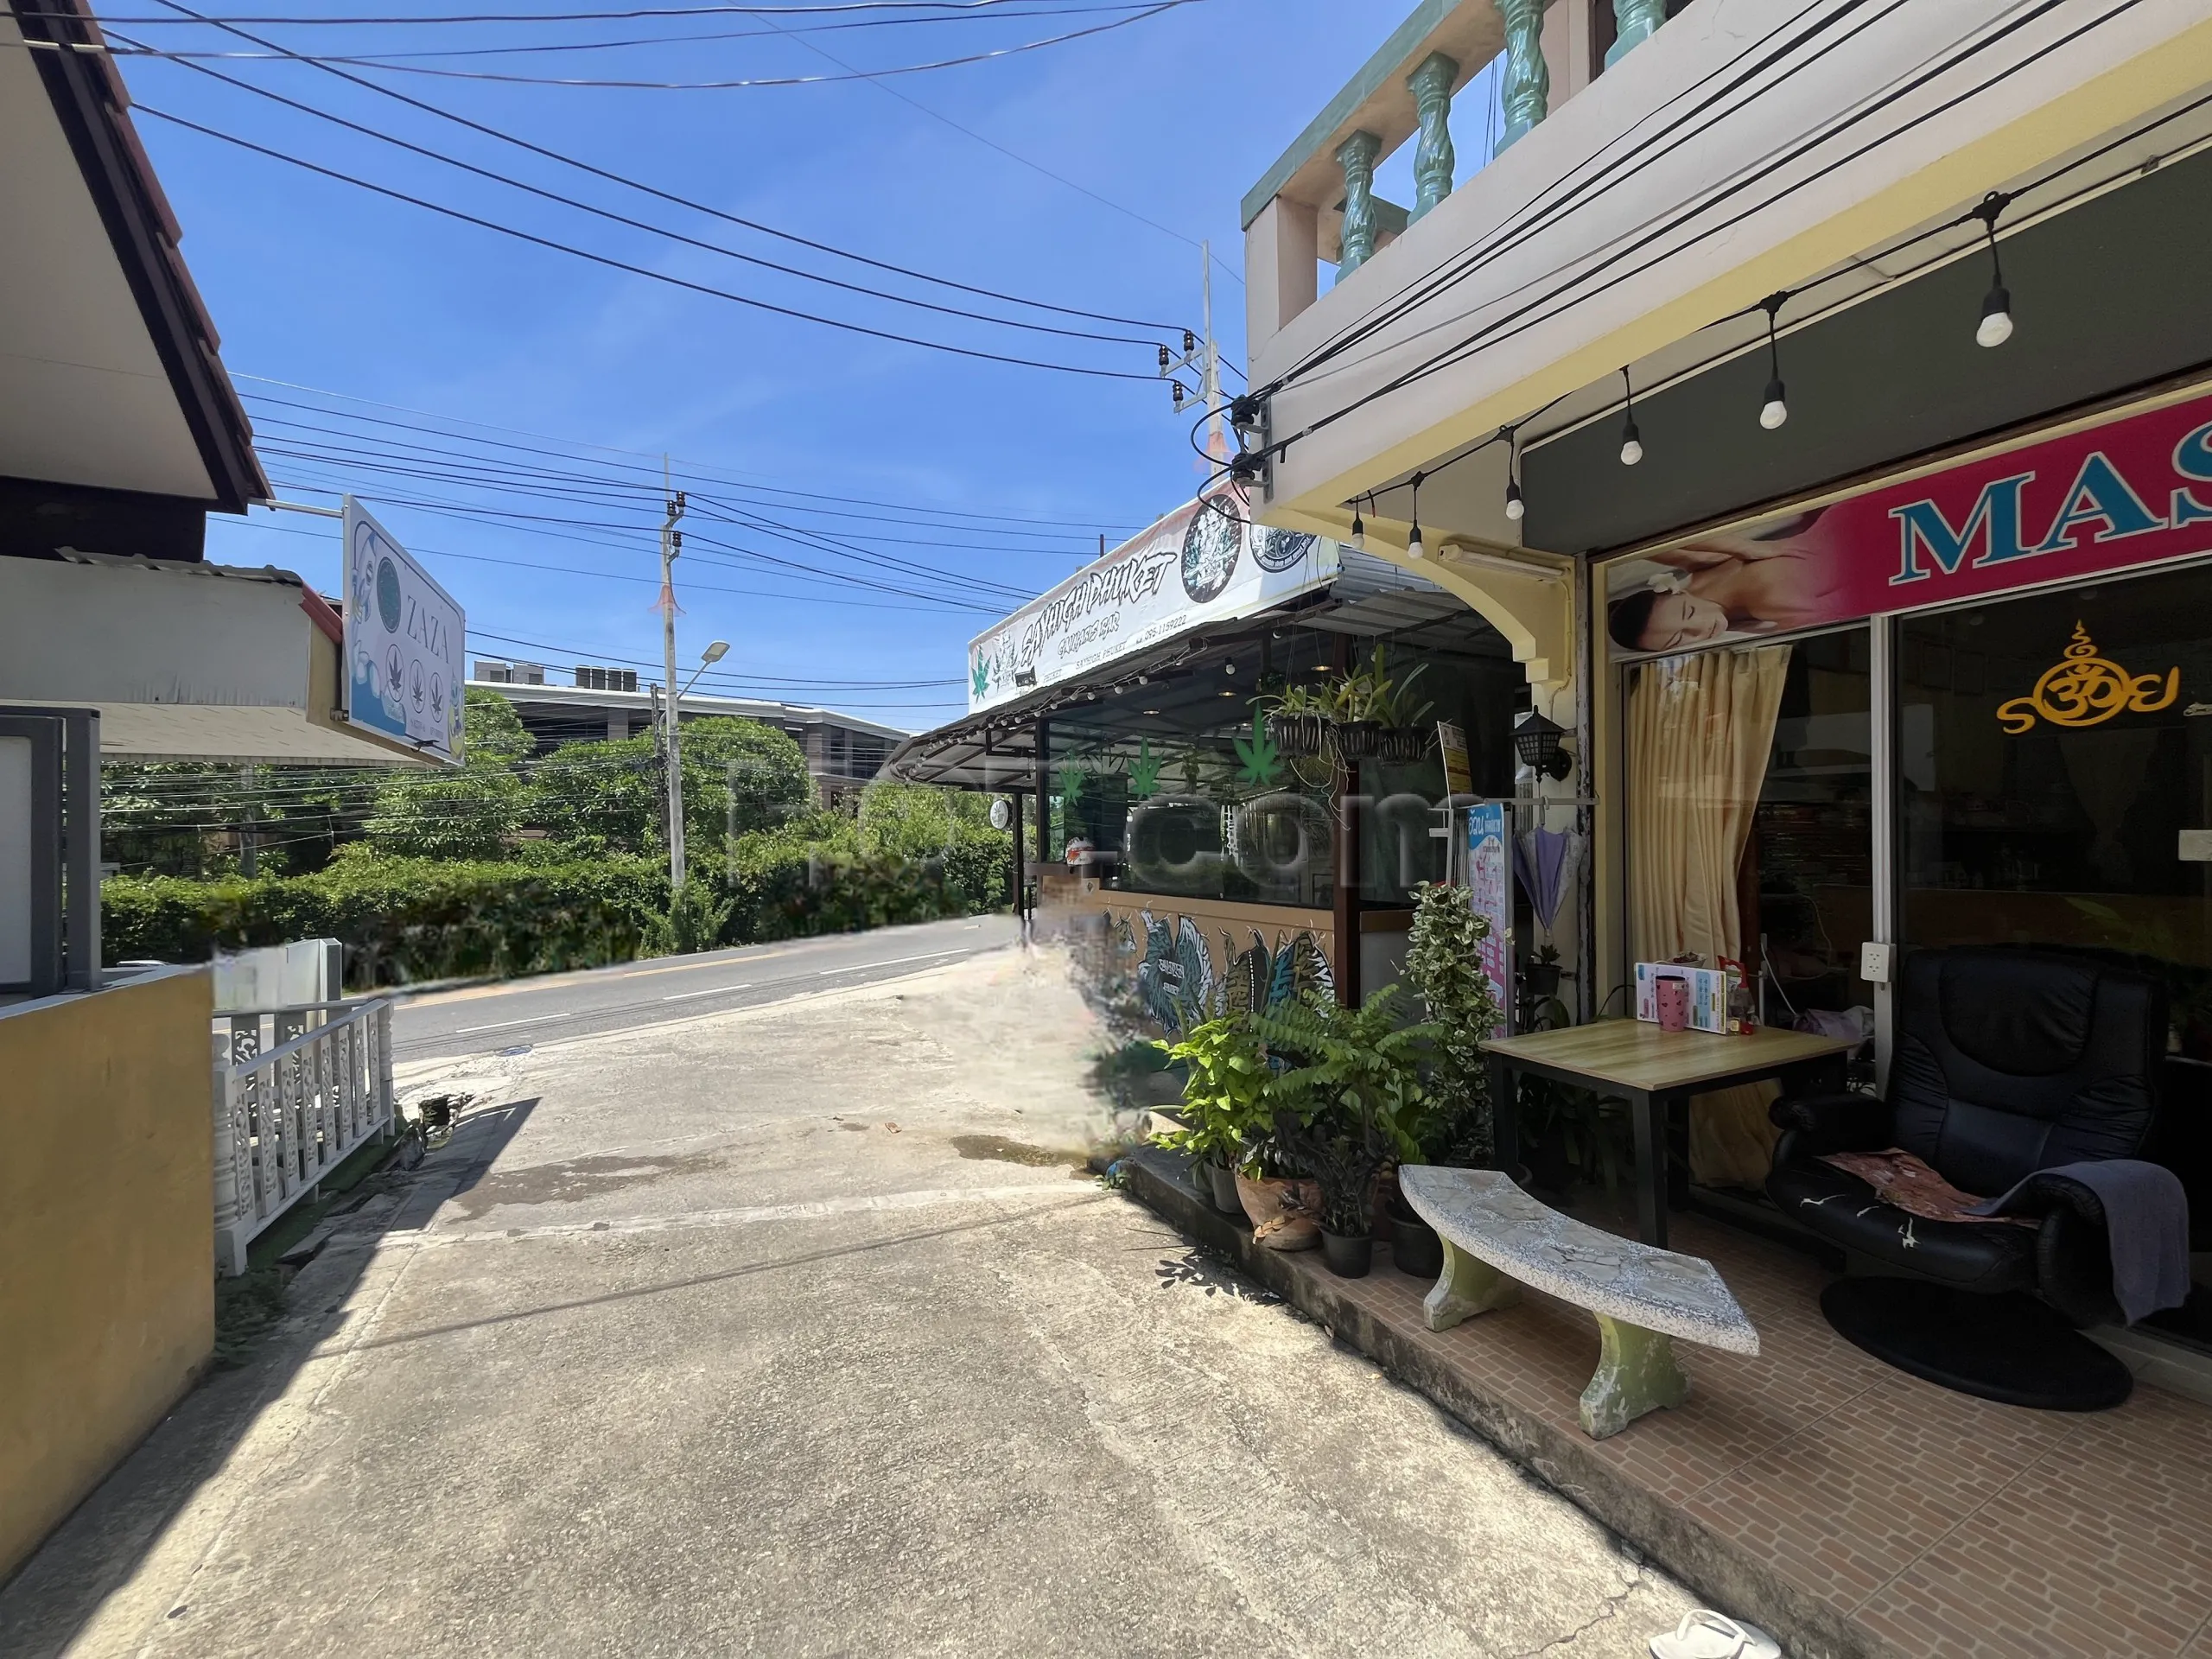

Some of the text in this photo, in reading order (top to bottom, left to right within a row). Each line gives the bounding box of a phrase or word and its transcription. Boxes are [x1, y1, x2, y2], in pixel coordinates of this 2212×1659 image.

[407, 594, 450, 664] ZAZA
[1020, 553, 1178, 668] SAYHIGH PHUKET
